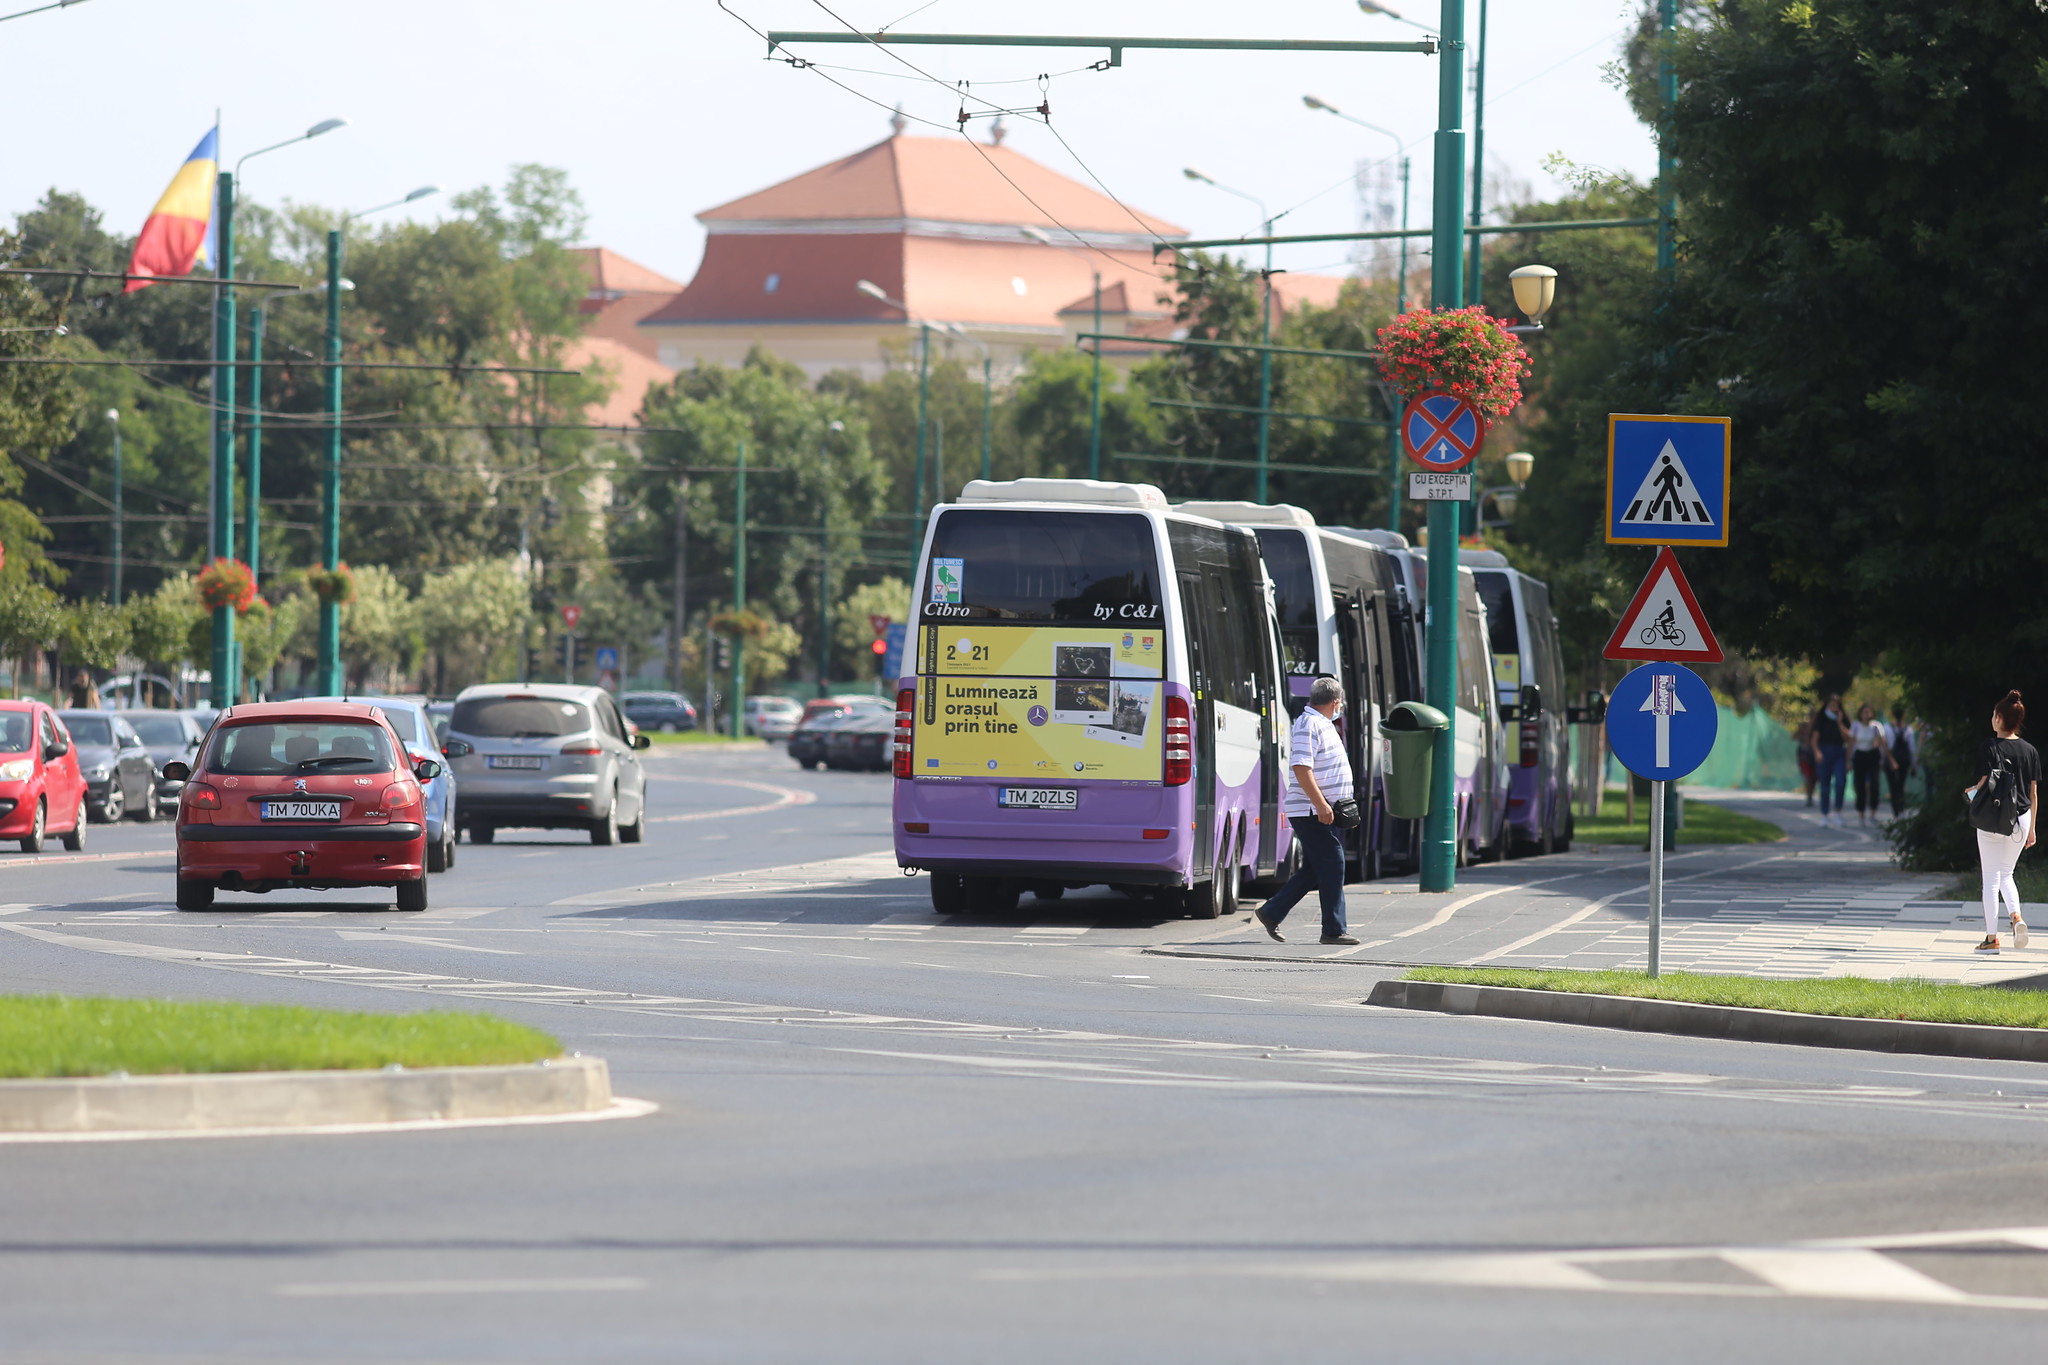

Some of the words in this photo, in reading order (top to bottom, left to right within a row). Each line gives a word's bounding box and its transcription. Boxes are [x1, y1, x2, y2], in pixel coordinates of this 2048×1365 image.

[1415, 474, 1426, 484] CU
[1428, 488, 1454, 498] S.T.P.T.
[924, 602, 970, 617] Cibro
[1093, 603, 1114, 621] by
[1119, 603, 1159, 618] C&I
[945, 683, 1038, 700] Luminează
[945, 702, 998, 719] orașul
[945, 718, 980, 736] prin
[984, 719, 1018, 734] tine
[1008, 790, 1027, 803] TM
[1032, 790, 1076, 804] 20ZLS
[268, 803, 288, 816] TM
[292, 803, 338, 816] 70UKA
